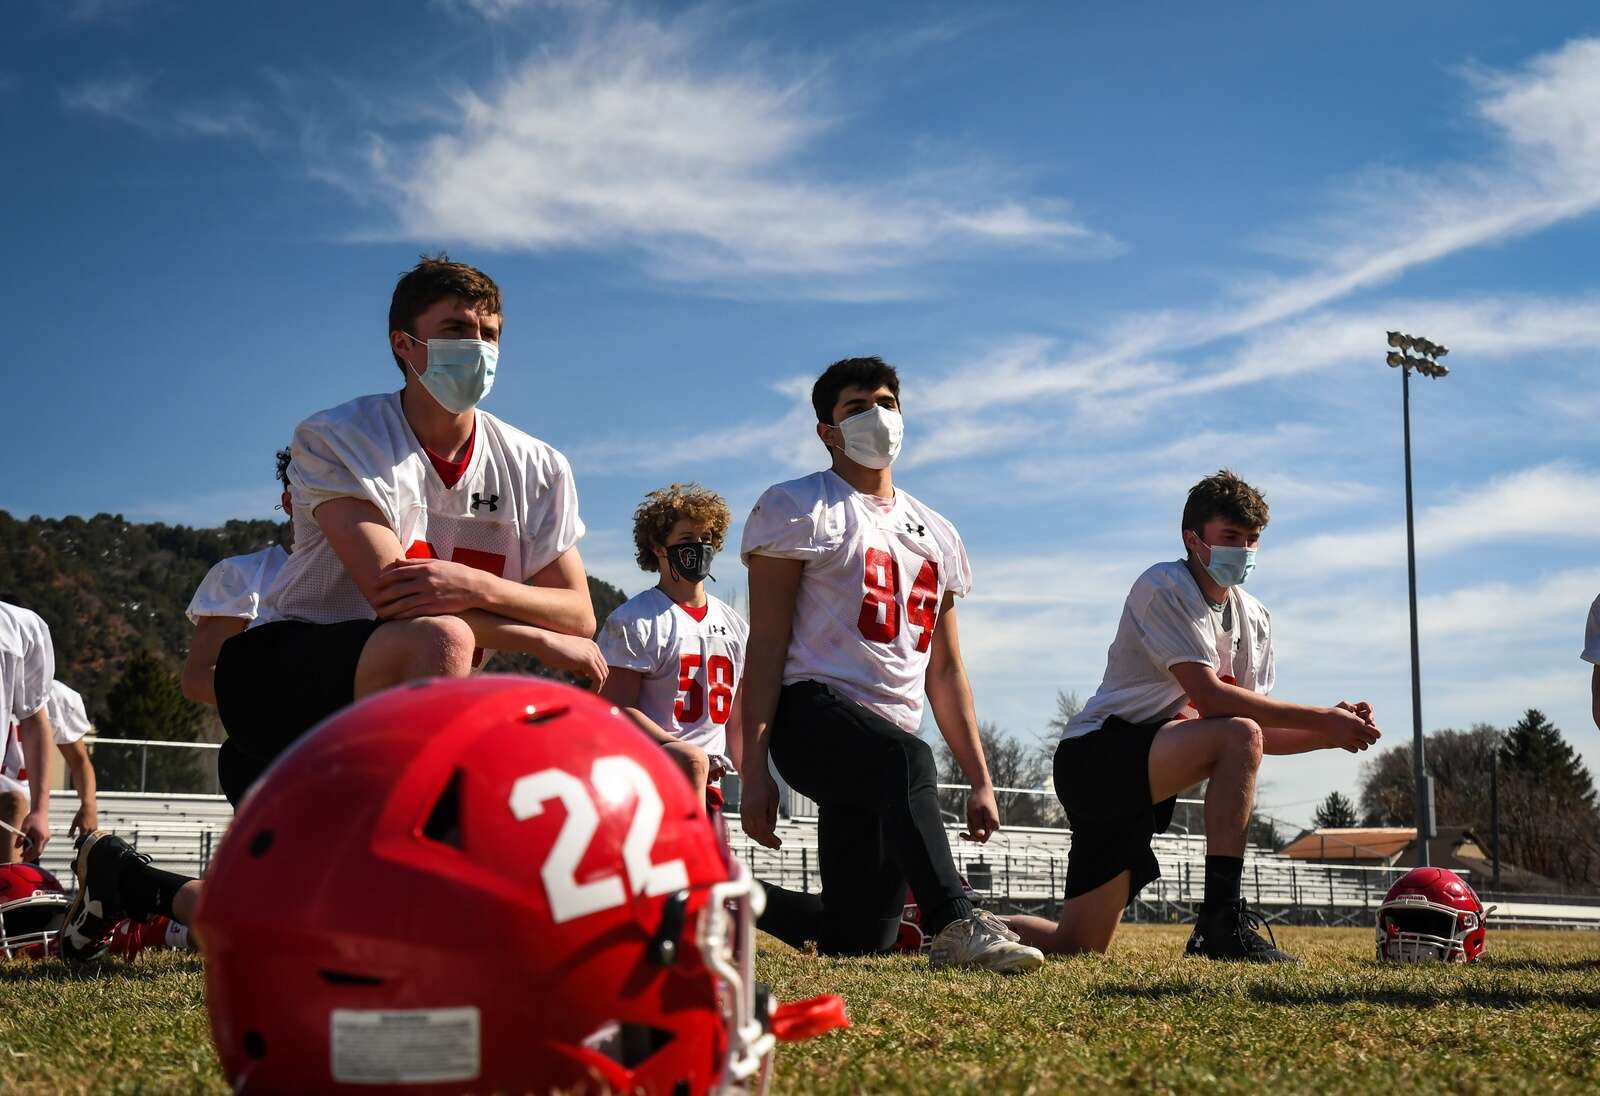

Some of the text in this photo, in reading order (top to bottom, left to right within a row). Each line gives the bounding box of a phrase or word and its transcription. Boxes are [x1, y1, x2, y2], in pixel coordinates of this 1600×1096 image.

[857, 547, 938, 652] 84
[674, 654, 734, 724] 58
[509, 755, 690, 924] 22
